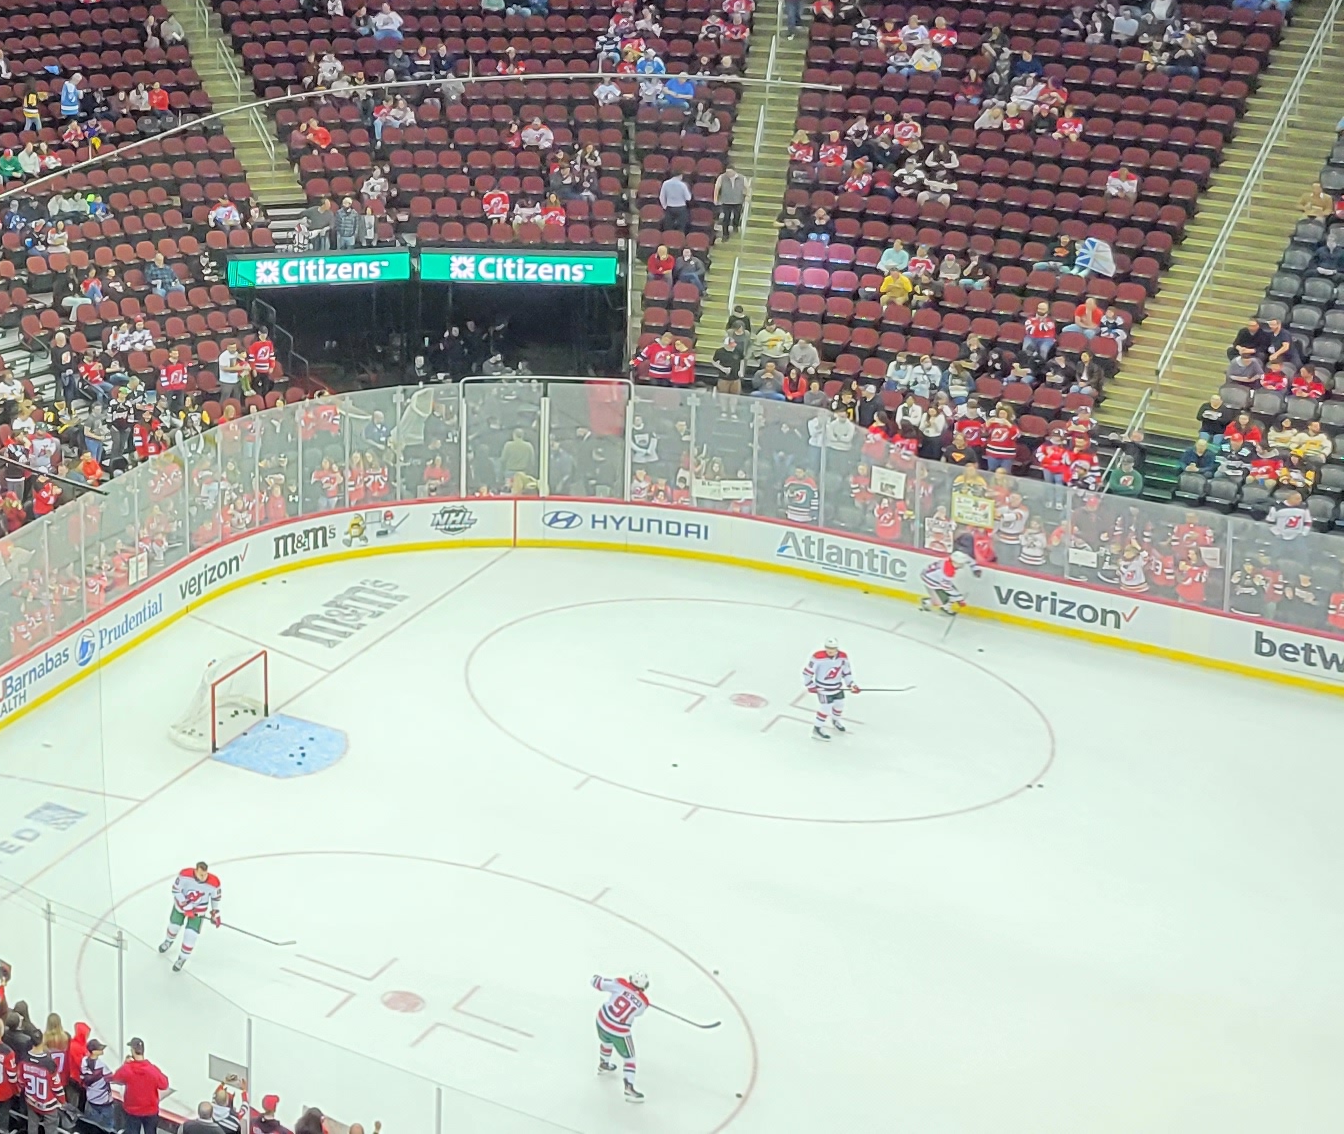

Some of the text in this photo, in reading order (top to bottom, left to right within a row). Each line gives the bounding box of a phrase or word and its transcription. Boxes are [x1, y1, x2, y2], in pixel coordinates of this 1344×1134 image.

[281, 258, 381, 284] Citizens
[478, 256, 583, 282] Citizens
[431, 509, 477, 528] NHL
[591, 513, 709, 540] HYUNDAI
[777, 531, 908, 579] Atlantic
[179, 553, 240, 600] verizon
[993, 584, 1121, 630] verizon
[99, 592, 164, 651] Prudential
[610, 997, 632, 1025] 91
[24, 1074, 47, 1099] 30
